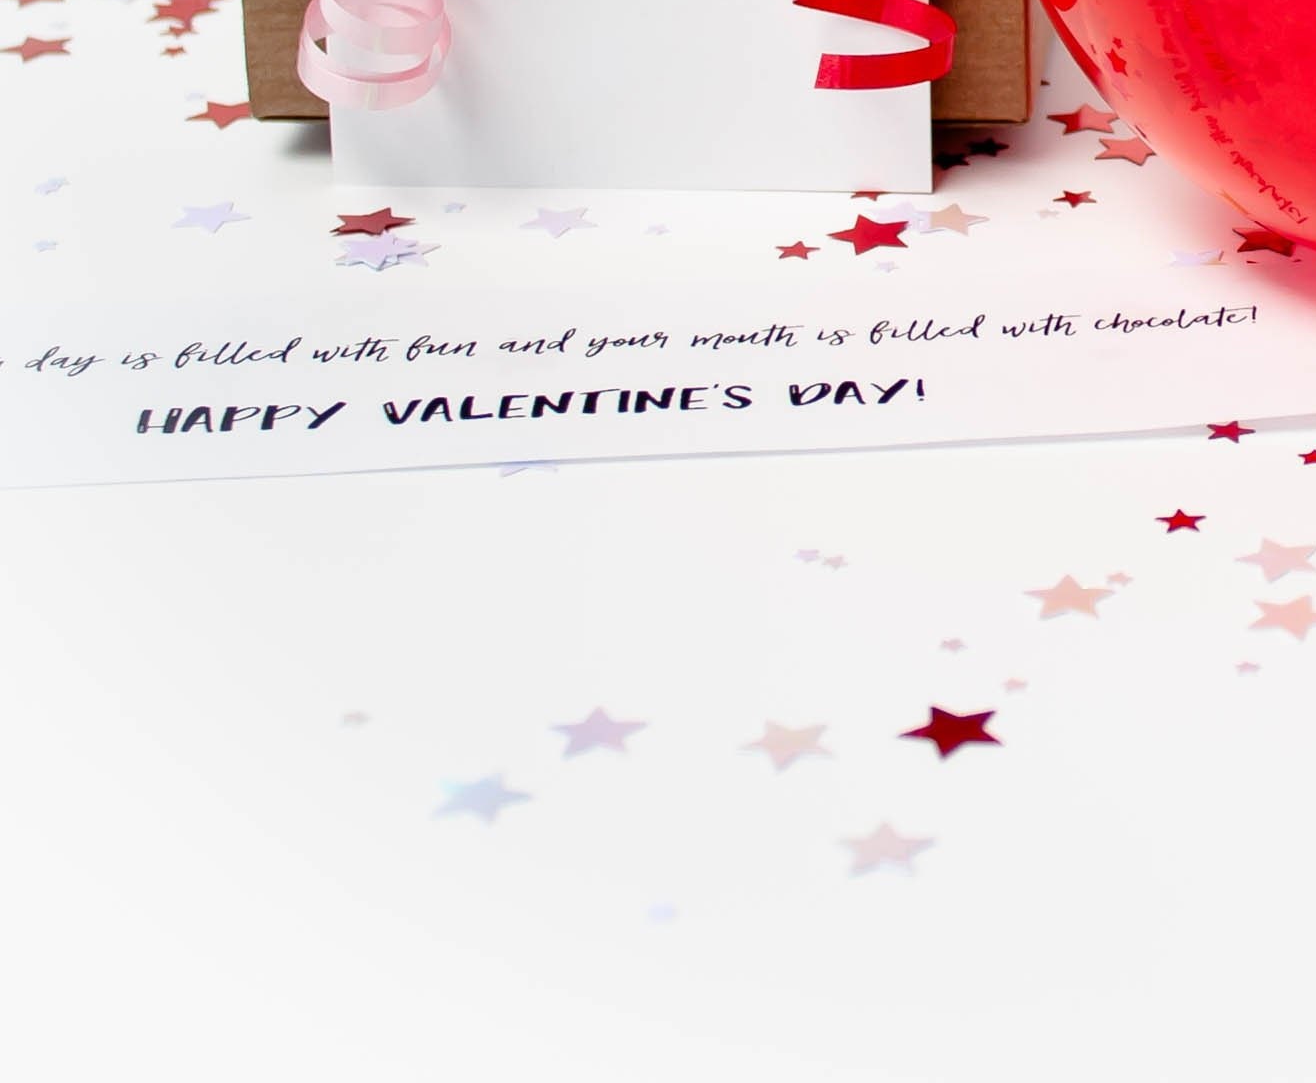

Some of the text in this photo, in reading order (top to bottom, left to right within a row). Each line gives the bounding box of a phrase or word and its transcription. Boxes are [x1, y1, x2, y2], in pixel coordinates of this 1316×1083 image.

[24, 305, 1258, 377] day is filled with fun and your mouth is filled with chocolate!
[136, 378, 925, 435] HAPPY VALENTINE'S DAY!
